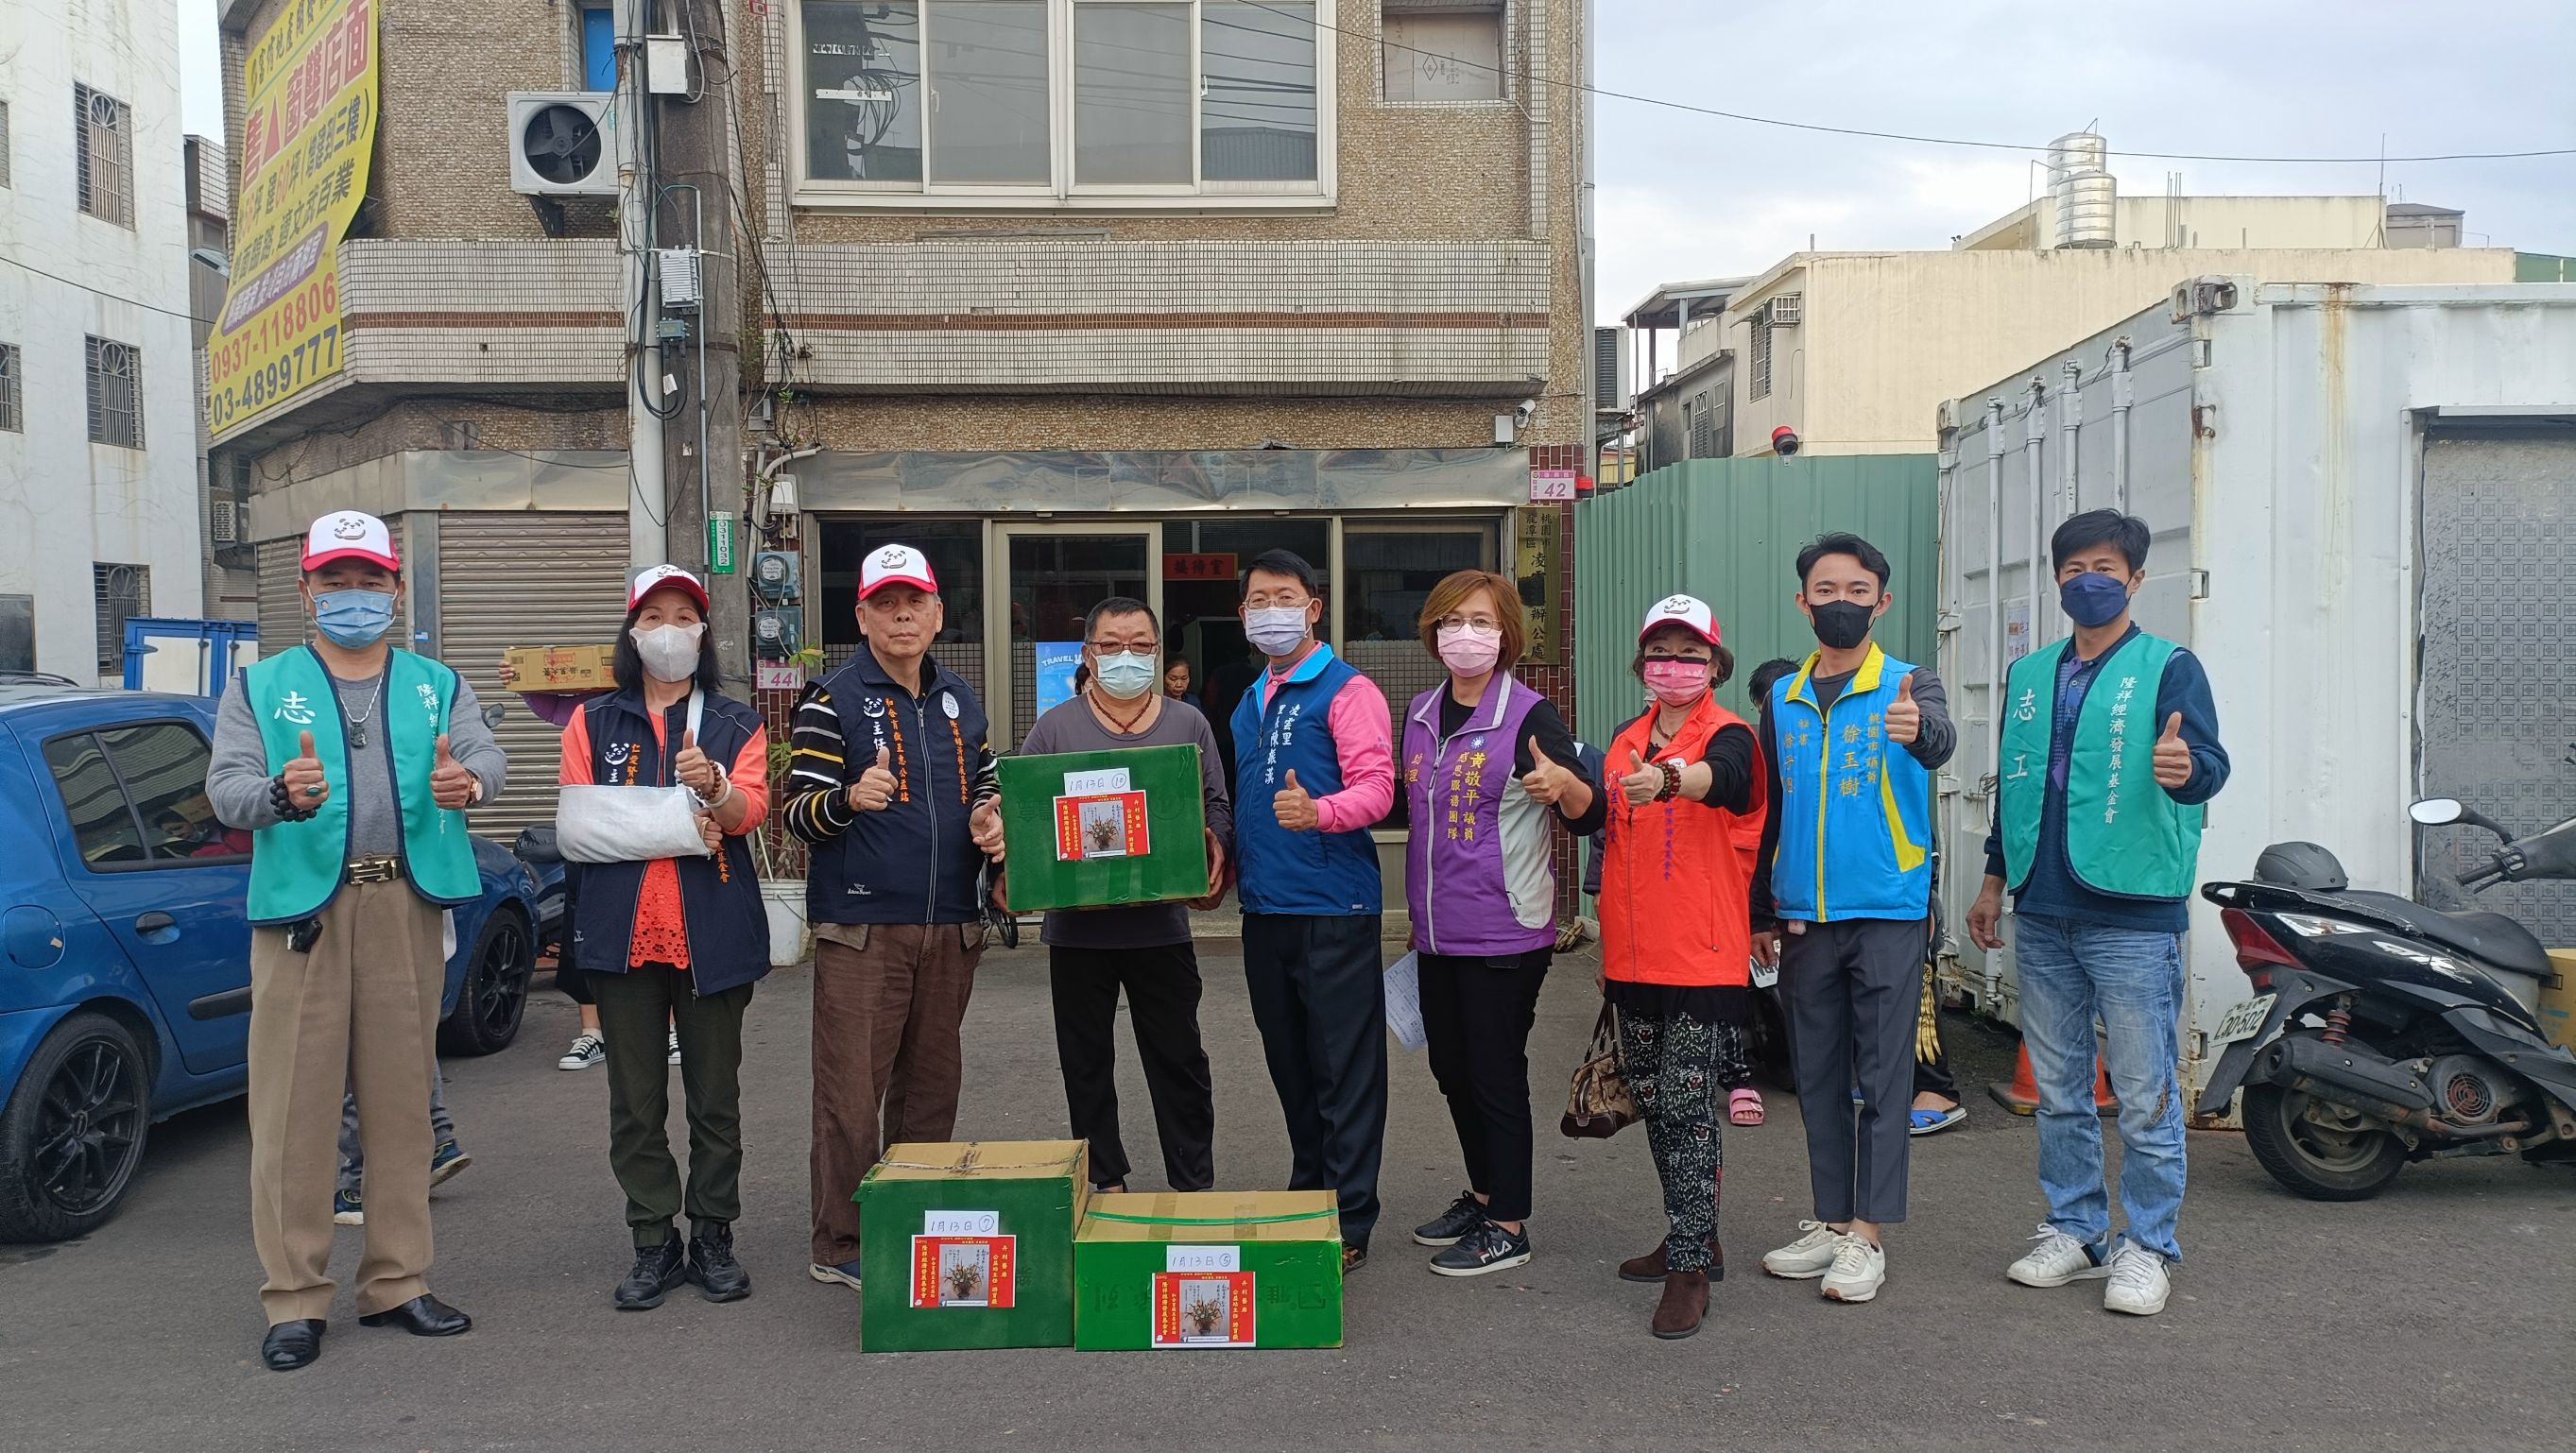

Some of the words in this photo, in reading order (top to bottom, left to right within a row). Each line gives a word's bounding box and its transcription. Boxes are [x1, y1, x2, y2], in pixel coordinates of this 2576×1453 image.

[213, 272, 336, 384] 0937-118806
[214, 324, 337, 426] 03-4899777
[1544, 483, 1567, 498] 42
[1525, 513, 1537, 549] 龍潭區
[1540, 513, 1553, 549] 桃園市
[1041, 654, 1073, 667] TRAVEL
[771, 672, 793, 687] 44
[274, 691, 316, 725] 志
[1281, 704, 1300, 745] 凌雲里
[2006, 689, 2036, 780] 志工
[2104, 676, 2138, 825] 隆祥經濟發展基金會
